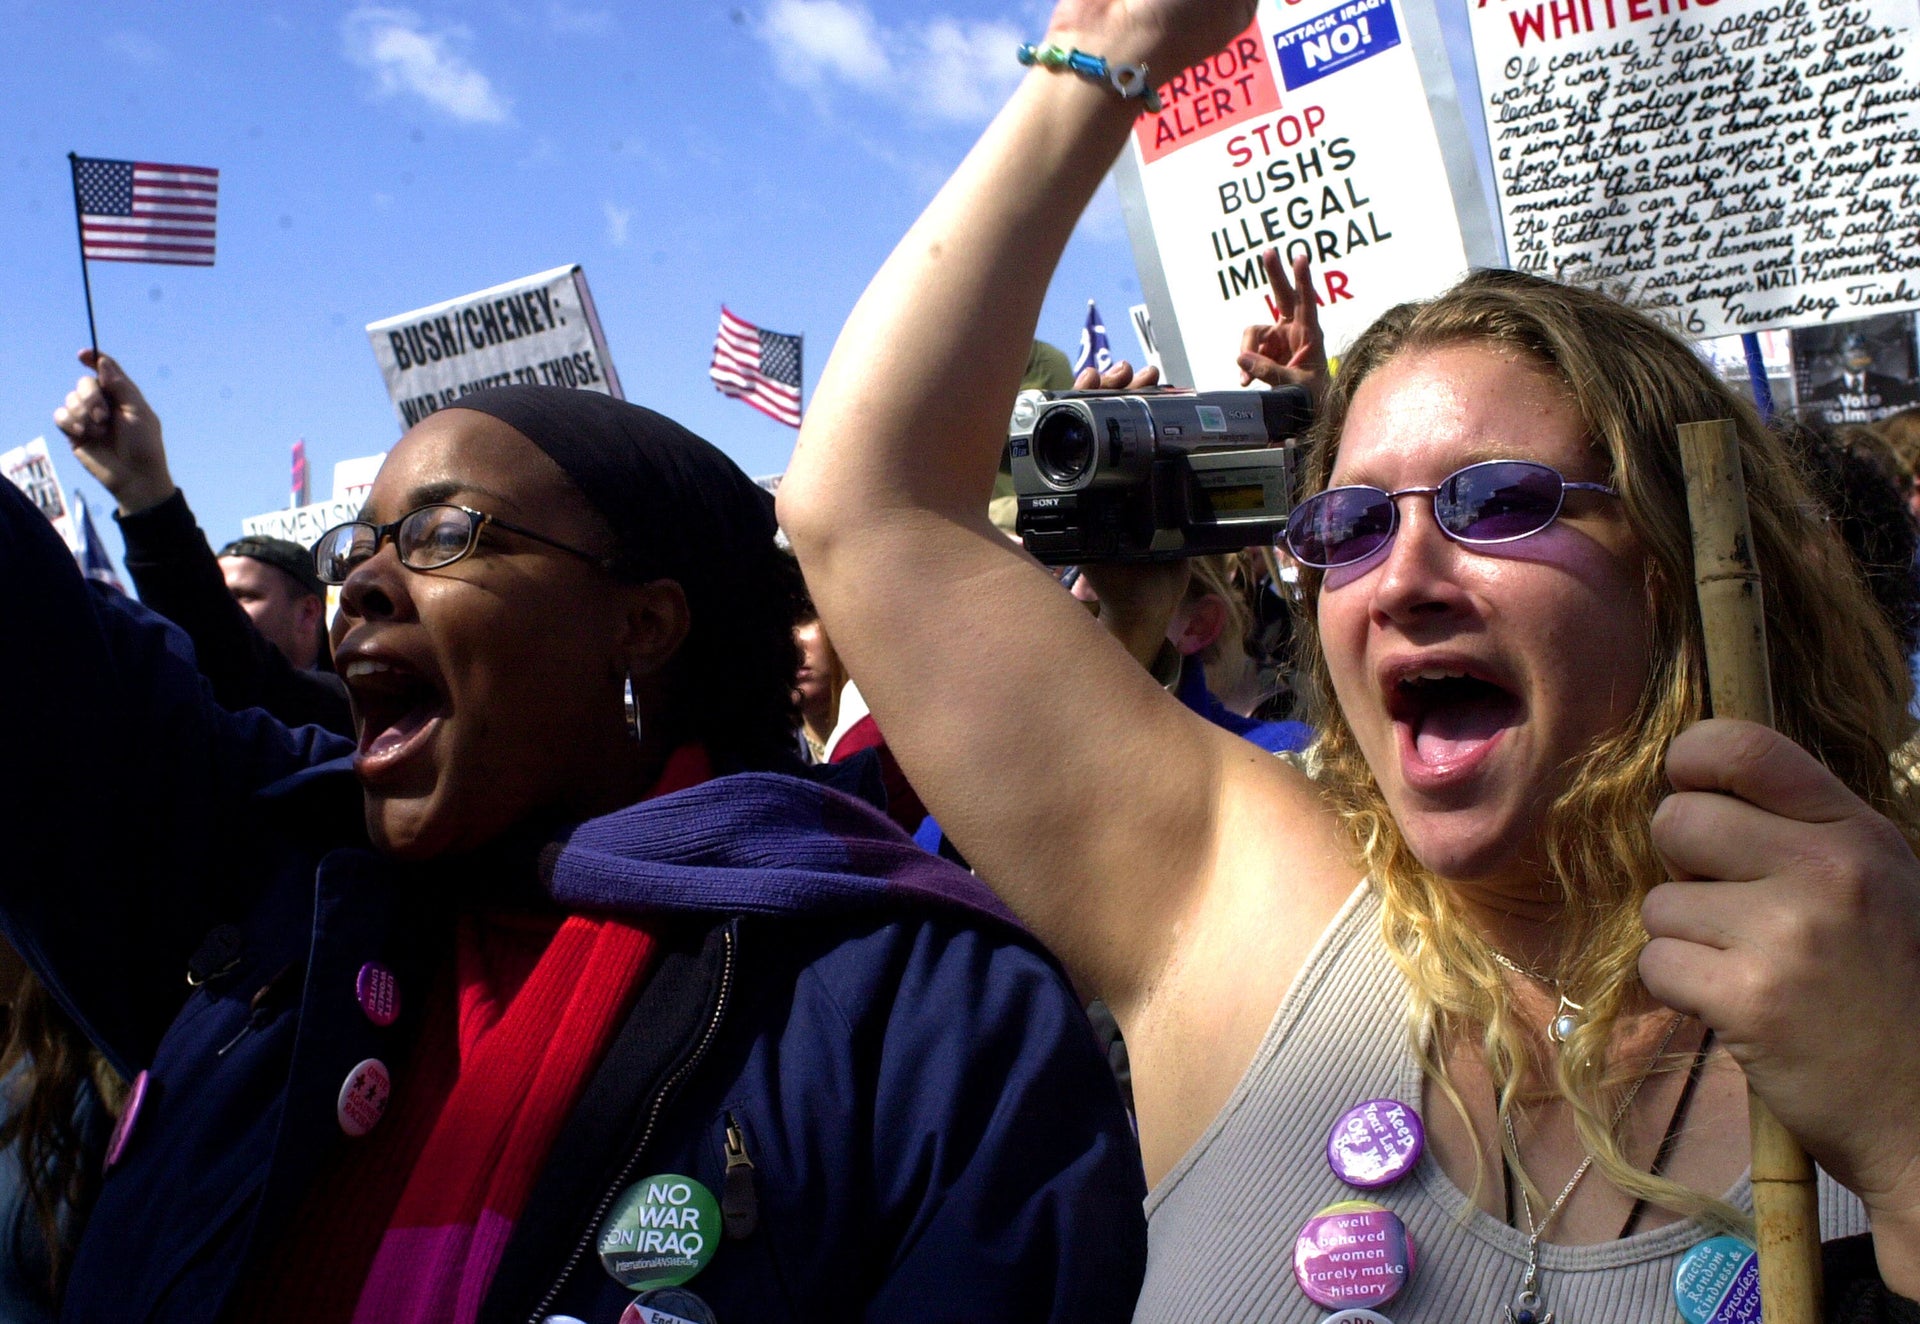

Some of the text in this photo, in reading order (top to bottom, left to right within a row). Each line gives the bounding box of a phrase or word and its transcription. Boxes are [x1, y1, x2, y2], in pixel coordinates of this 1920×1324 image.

[1277, 14, 1338, 49] ATTACK
[1302, 16, 1372, 69] NO!
[1491, 6, 1871, 105] want war but after all it's the
[1504, 0, 1809, 86] Of course the people
[1140, 38, 1262, 120] RROR
[1497, 47, 1905, 141] mine the policy and it's always
[1587, 81, 1608, 113] of
[1614, 75, 1652, 98] the
[1655, 57, 1754, 90] country
[1764, 43, 1817, 65] who
[1823, 26, 1909, 54] deter-
[1155, 73, 1254, 149] ALERT
[1226, 105, 1326, 168] STOP
[1499, 146, 1511, 161] a
[1520, 129, 1596, 160] simple
[1692, 105, 1720, 122] to
[1722, 92, 1773, 120] drag
[1777, 80, 1814, 105] the
[1820, 63, 1902, 103] people
[1503, 153, 1559, 182] along
[1652, 129, 1692, 150] it's
[1698, 124, 1714, 140] a
[1861, 82, 1920, 119] fascis
[1506, 161, 1629, 197] dictatorship
[1635, 159, 1650, 173] a
[1785, 128, 1810, 145] or
[1818, 125, 1832, 139] a
[1793, 147, 1817, 164] or
[1824, 142, 1859, 159] no
[1862, 126, 1920, 150] voice
[1218, 137, 1356, 214] BUSH'S
[1514, 213, 1549, 236] the
[1552, 202, 1630, 236] people
[1638, 196, 1676, 212] can
[1687, 177, 1771, 205] always
[1777, 164, 1802, 186] be
[1812, 147, 1897, 187] brought
[1211, 177, 1371, 262] ILLEGAL
[1515, 234, 1547, 253] the
[1552, 223, 1636, 247] bidding
[1639, 213, 1661, 240] of
[1664, 208, 1700, 229] the
[1793, 180, 1832, 202] that
[1835, 180, 1860, 198] is
[1866, 174, 1920, 200] easy
[1600, 237, 1656, 259] have
[1662, 231, 1686, 247] to
[1689, 225, 1712, 242] do
[1744, 211, 1784, 235] tell
[1786, 207, 1839, 229] them
[1846, 194, 1892, 221] they
[1663, 245, 1700, 265] and
[1803, 222, 1836, 243] the
[1753, 248, 1795, 272] and
[1757, 268, 1797, 292] NAZI
[388, 286, 567, 371] BUSH/CHENEY:
[1725, 293, 1839, 325] Nuremberg
[539, 350, 600, 388] THOSE
[1032, 498, 1059, 508] SONY
[1347, 1118, 1371, 1146] Off
[1364, 1103, 1403, 1167] Your Law
[1386, 1105, 1415, 1146] Keep
[638, 1206, 699, 1230] WAR
[646, 1184, 692, 1206] NO
[607, 1230, 703, 1260] ON IRAQ
[1319, 1230, 1386, 1247] behaved
[1338, 1215, 1370, 1229] well
[1311, 1263, 1404, 1283] rarely make
[1328, 1249, 1385, 1262] women
[1679, 1245, 1713, 1294] Practice
[1687, 1252, 1725, 1303] Random
[1330, 1282, 1386, 1298] history
[1693, 1251, 1742, 1319] Kindness &
[1717, 1265, 1759, 1324] Senseless
[1736, 1293, 1759, 1324] Acts
